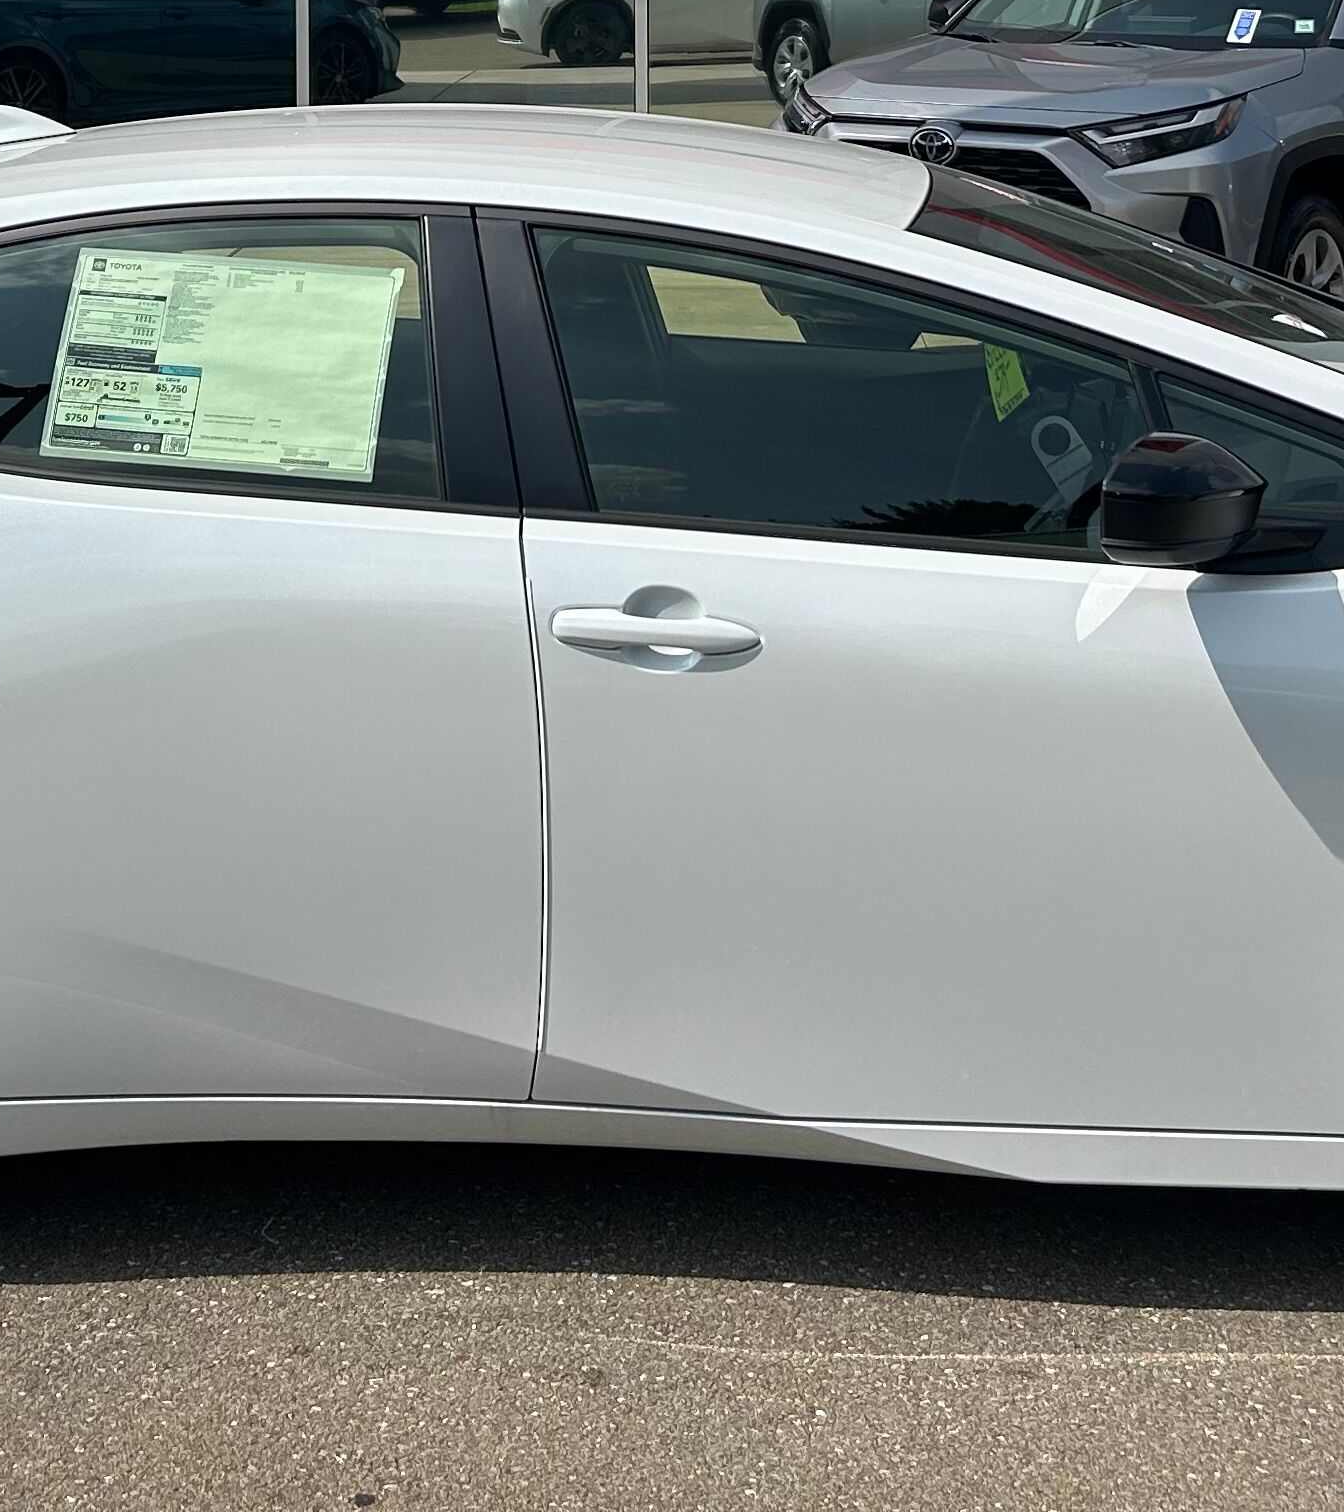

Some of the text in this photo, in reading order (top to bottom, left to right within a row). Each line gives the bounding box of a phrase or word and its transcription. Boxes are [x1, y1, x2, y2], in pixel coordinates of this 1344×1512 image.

[110, 262, 143, 271] TOYOTA
[70, 378, 90, 388] 127
[112, 381, 127, 391] 52
[155, 383, 188, 394] $5,750
[64, 413, 88, 423] $750
